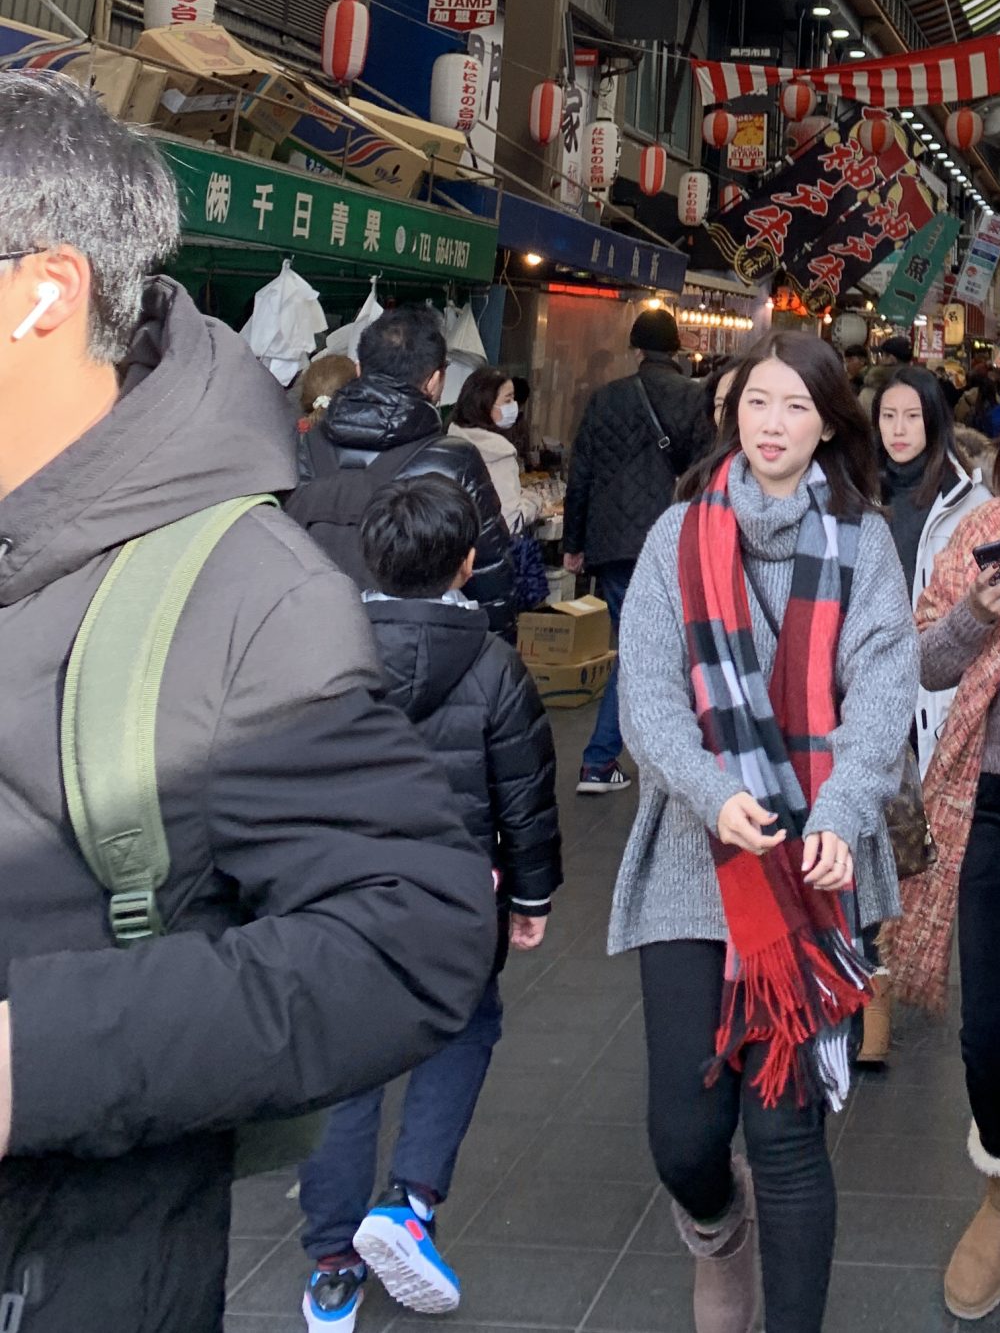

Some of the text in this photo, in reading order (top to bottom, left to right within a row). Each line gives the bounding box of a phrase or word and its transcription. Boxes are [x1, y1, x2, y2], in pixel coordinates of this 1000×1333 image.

[434, 9, 492, 25] 加盟店
[455, 60, 479, 132] なにわの台所
[730, 151, 764, 159] STAMP
[744, 138, 878, 257] 神戸牛
[419, 233, 471, 268] TEL 6641-7857
[807, 199, 910, 296] 神戸牛
